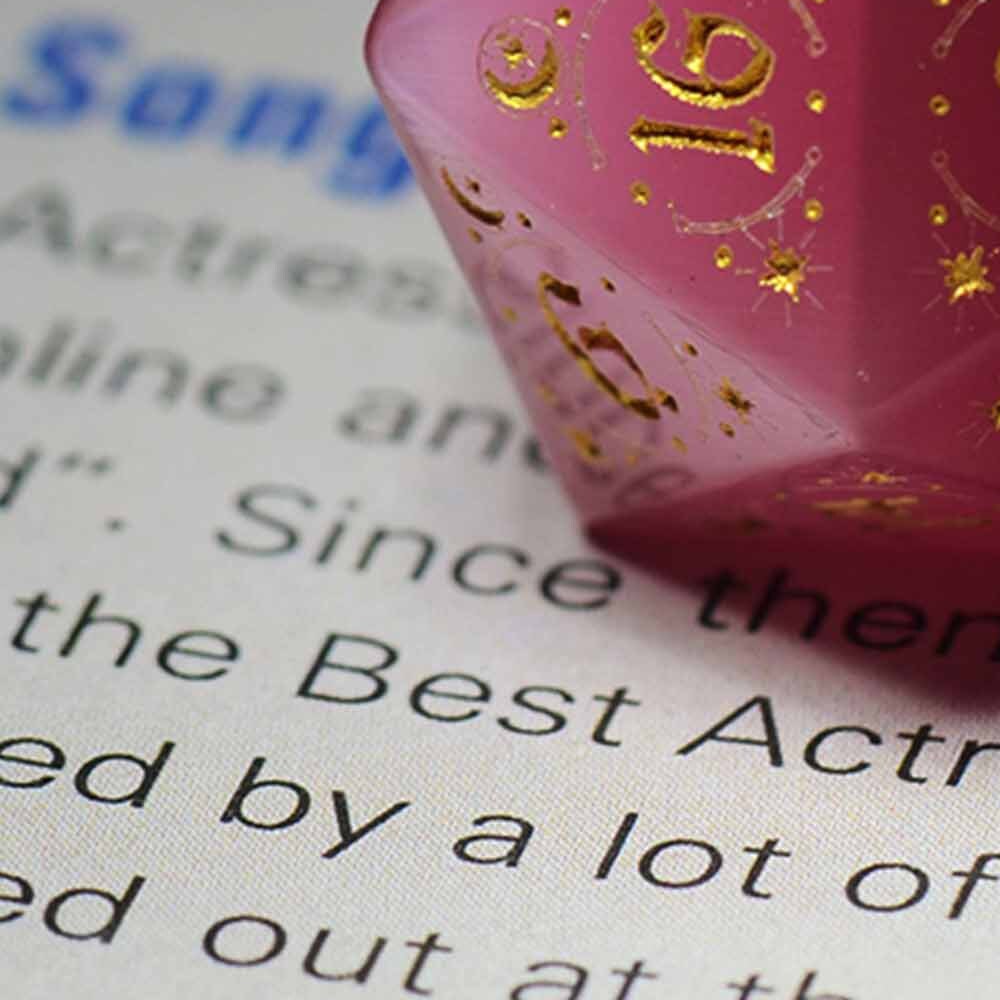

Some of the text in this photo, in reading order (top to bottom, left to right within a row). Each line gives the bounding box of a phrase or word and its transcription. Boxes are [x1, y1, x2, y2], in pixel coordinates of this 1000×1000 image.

[629, 0, 776, 173] 16
[214, 483, 624, 613] Since
[11, 592, 242, 682] the
[296, 633, 642, 748] Best
[220, 757, 411, 860] by
[453, 815, 536, 868] a
[594, 813, 792, 901] lot
[202, 915, 453, 997] out
